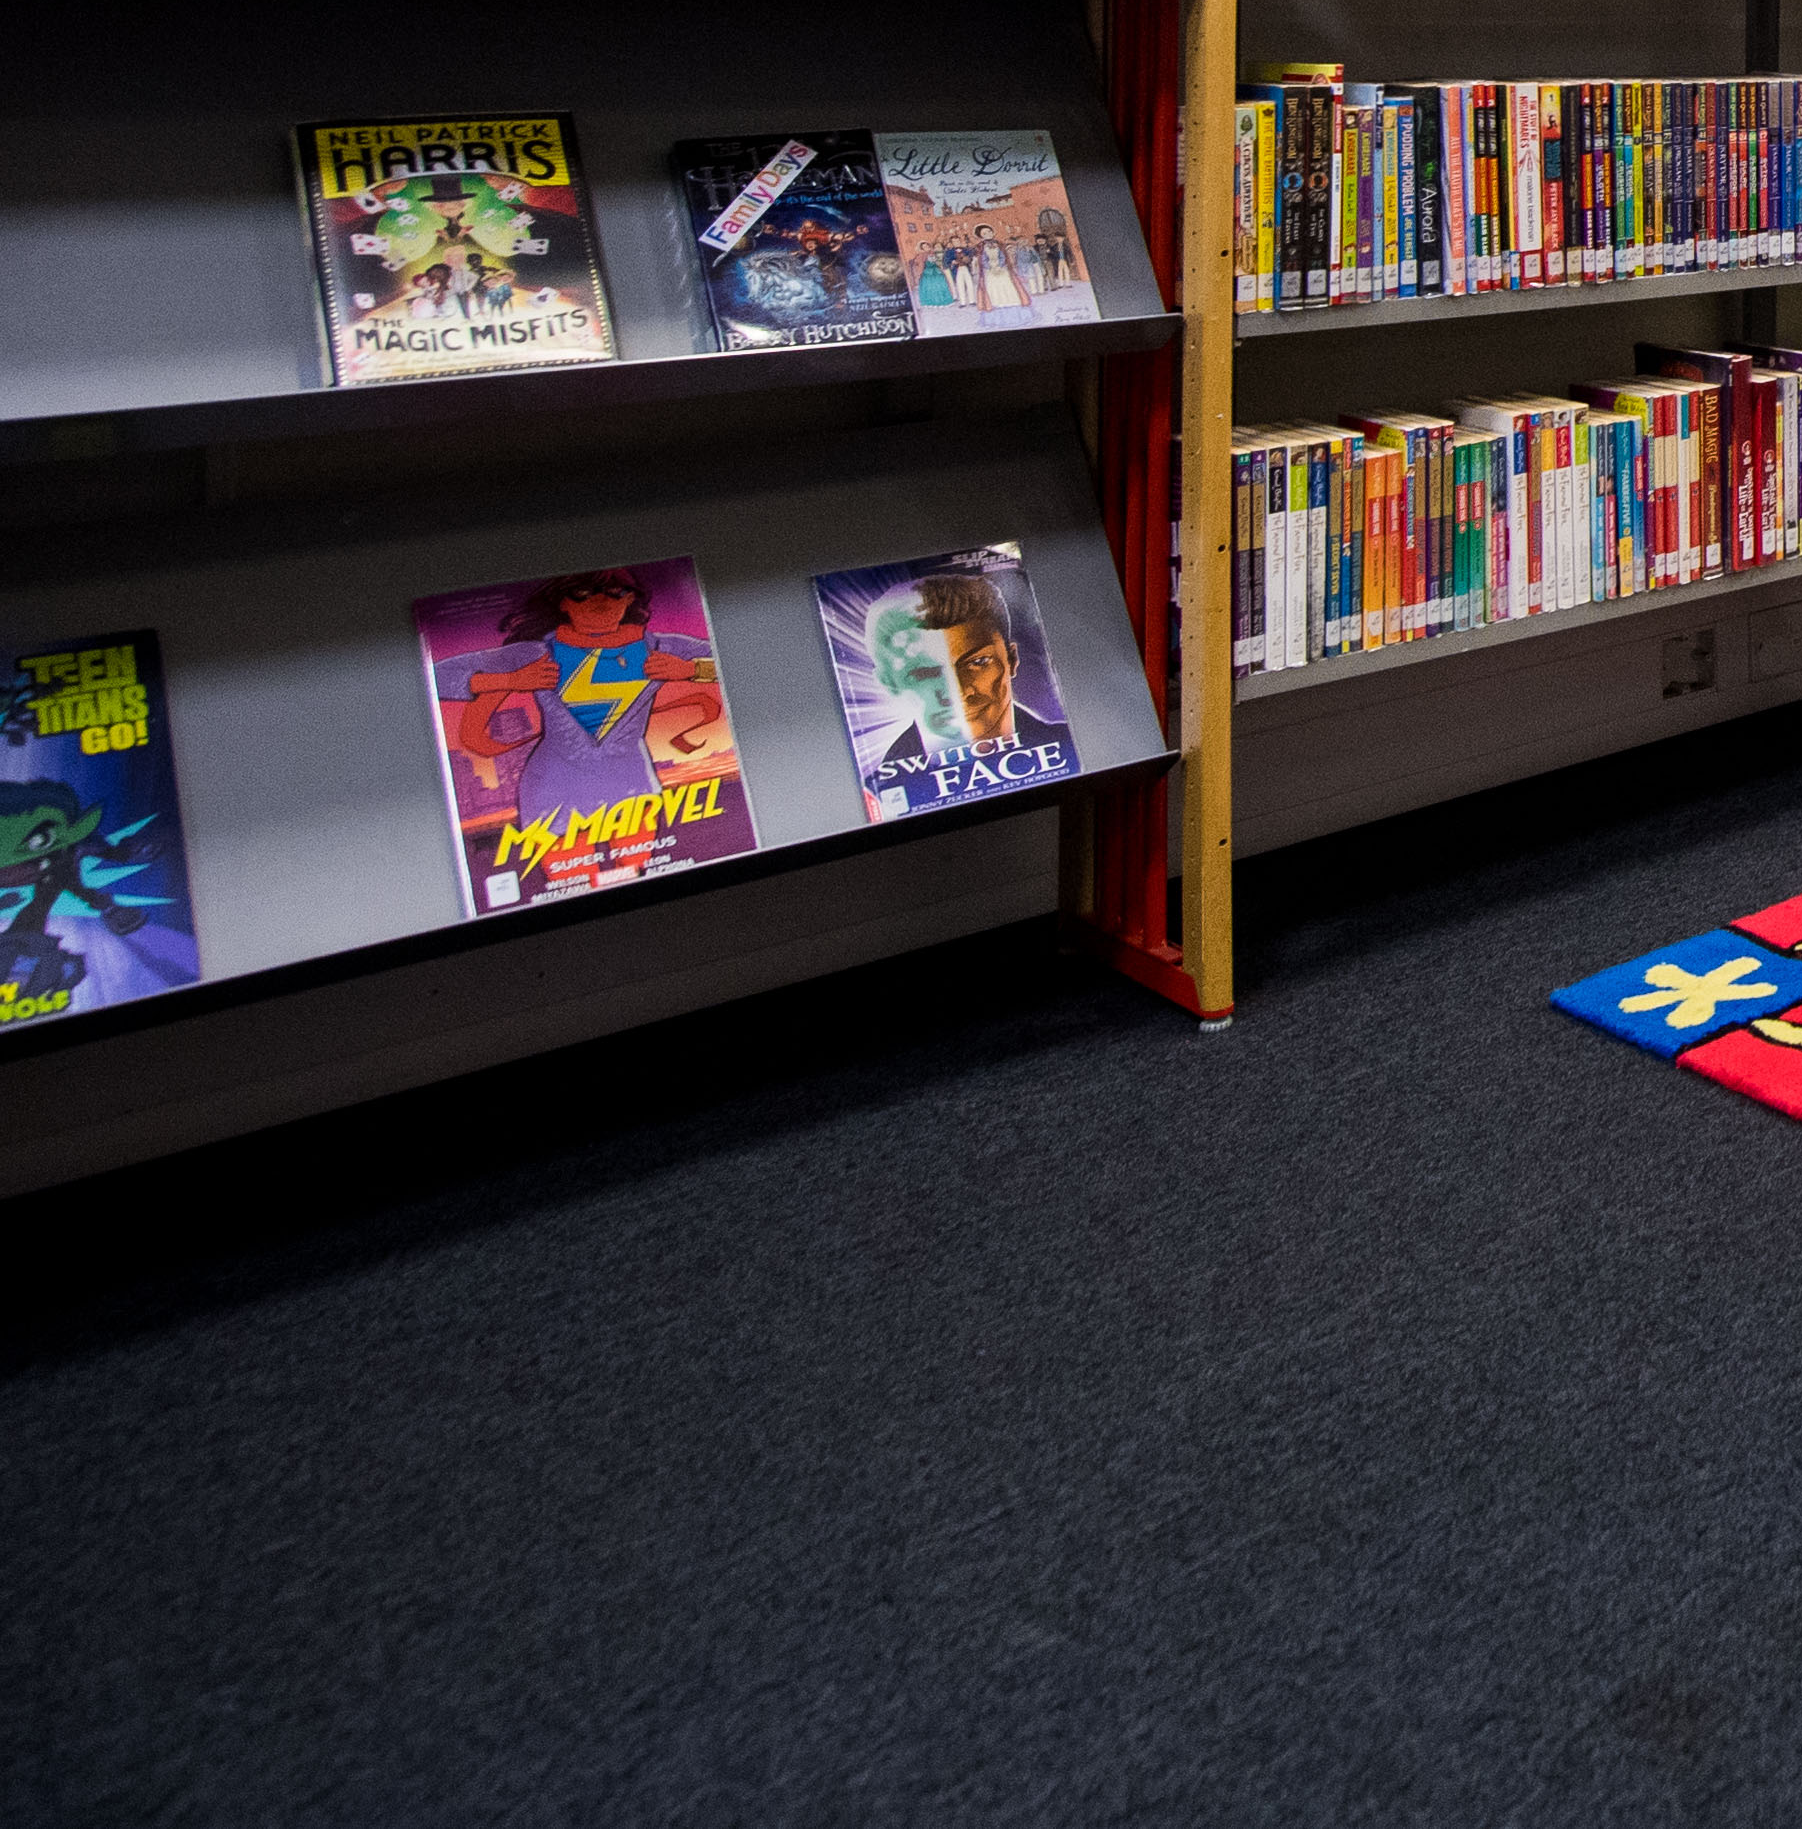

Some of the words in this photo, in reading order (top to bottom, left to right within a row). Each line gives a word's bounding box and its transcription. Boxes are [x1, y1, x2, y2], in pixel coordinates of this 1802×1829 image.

[330, 128, 402, 145] NEIL
[416, 123, 551, 144] PATRICK
[332, 141, 556, 193] HARRIS
[889, 147, 962, 180] Little
[973, 145, 1048, 176] Dorrit
[805, 312, 914, 344] HUTCHISON
[1705, 394, 1720, 424] BAD
[1705, 426, 1719, 464] MAGIC
[22, 644, 135, 685] TEEN
[27, 683, 149, 735] TITANS
[81, 719, 150, 755] GO!
[877, 732, 1023, 780] SWITCH
[929, 741, 1067, 799] FACE
[563, 777, 724, 852] MARVEL
[550, 851, 606, 874] SUPER
[610, 835, 678, 865] FAMOUS
